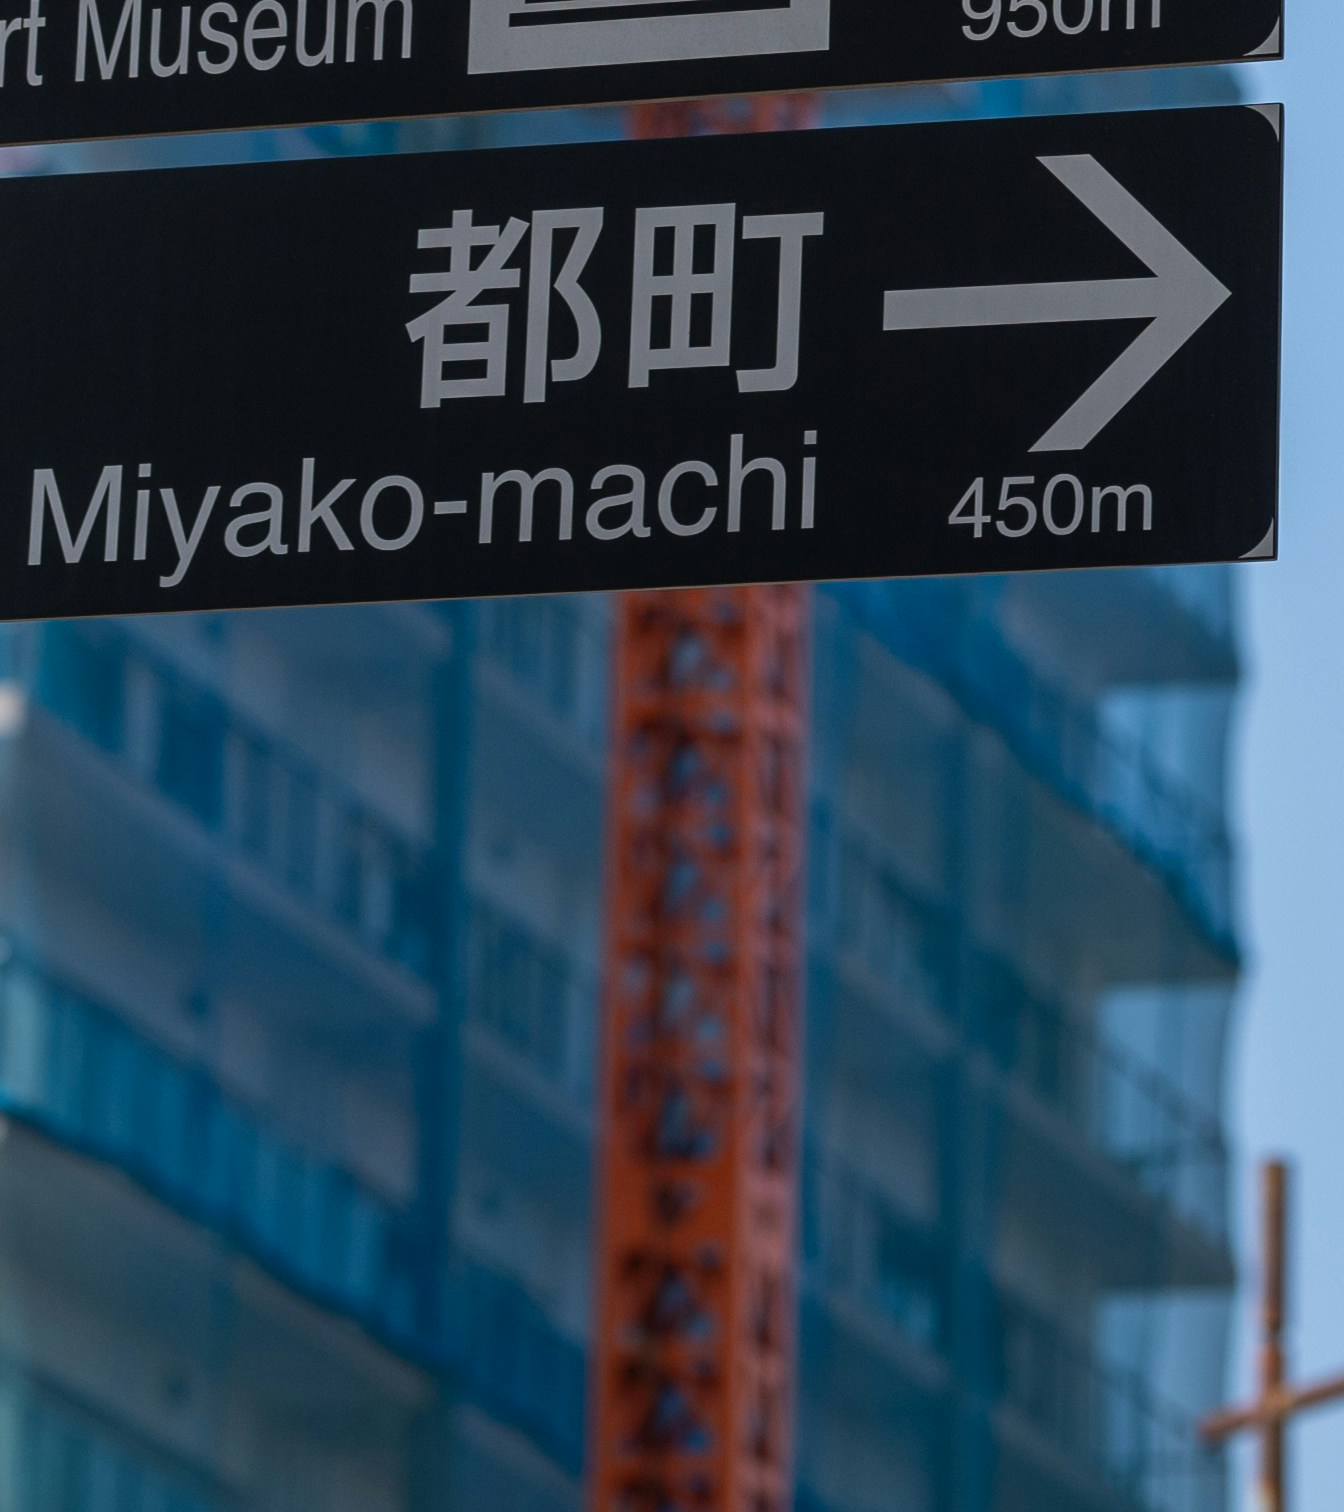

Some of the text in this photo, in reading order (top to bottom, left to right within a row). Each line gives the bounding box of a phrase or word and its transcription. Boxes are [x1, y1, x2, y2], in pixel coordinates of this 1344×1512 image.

[404, 201, 825, 410] 都町
[27, 431, 817, 589] Miyako-machi
[947, 472, 1153, 539] 450m
